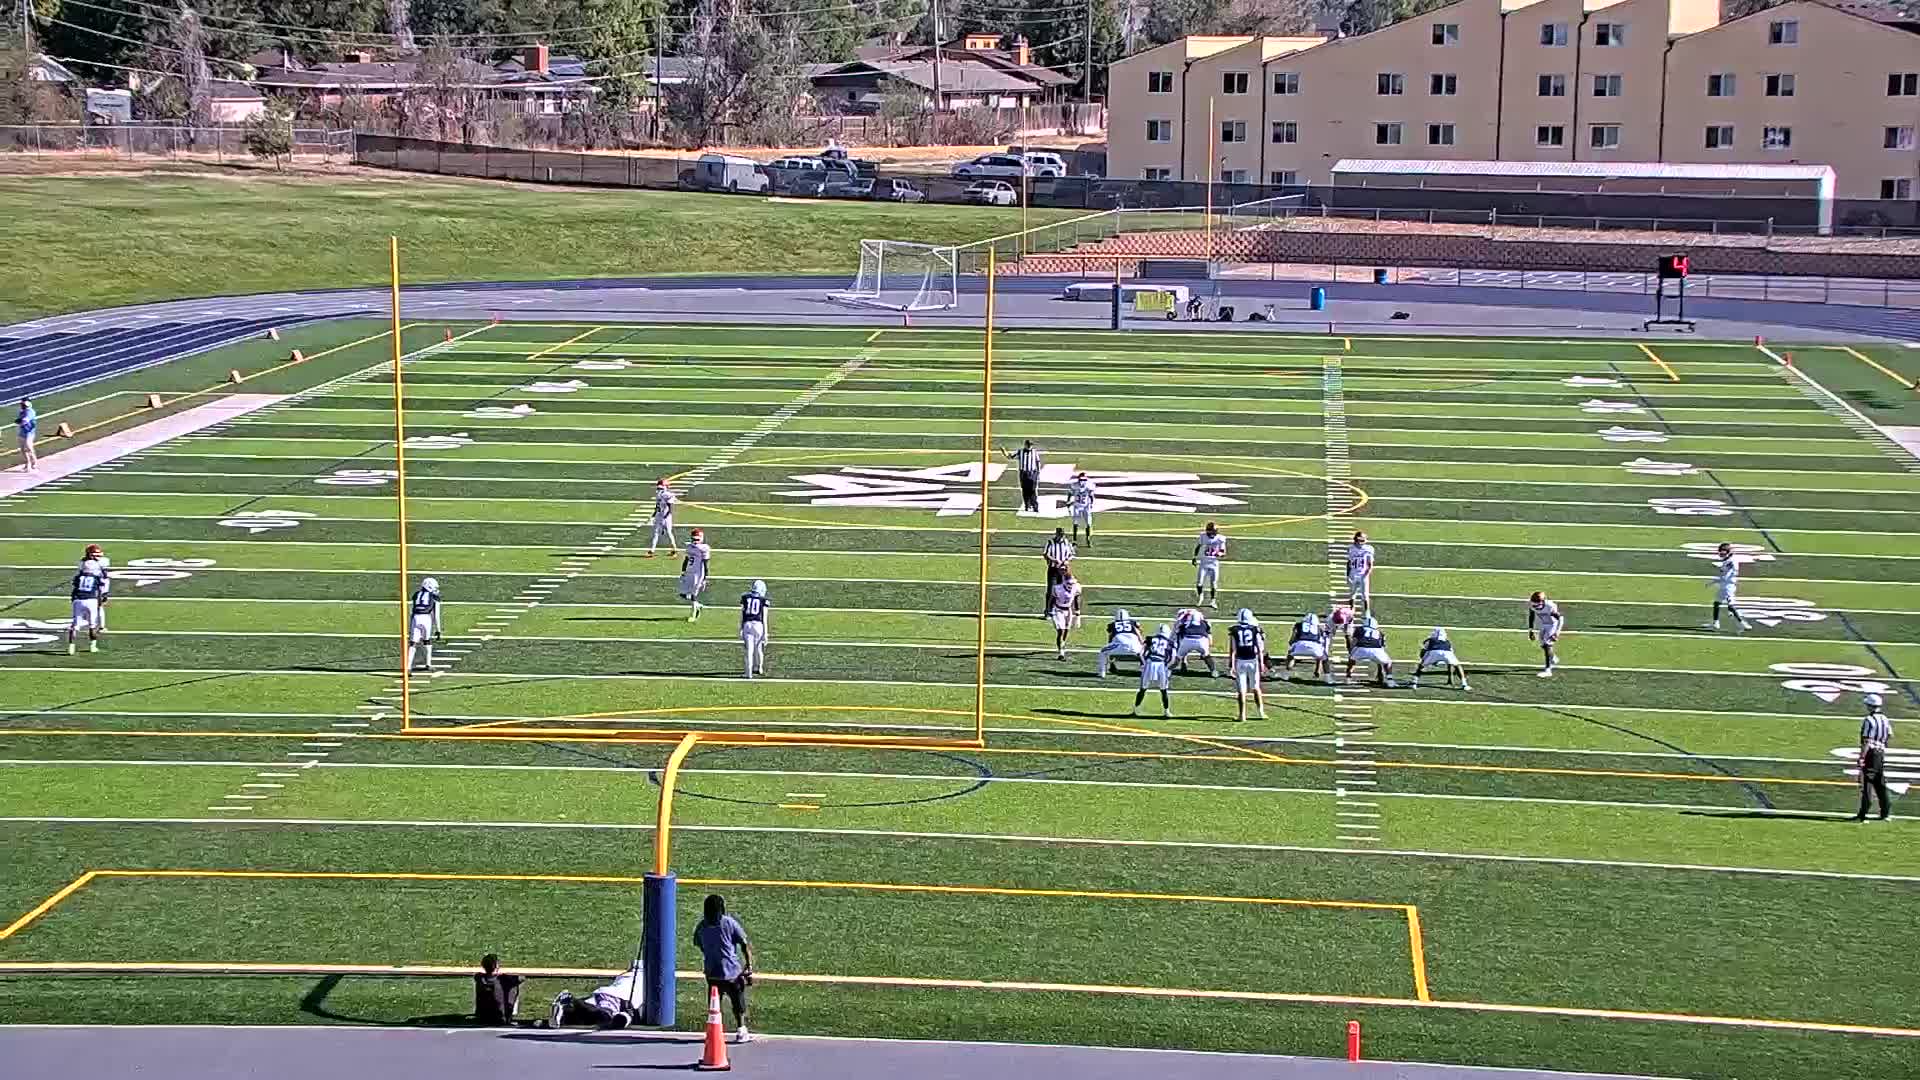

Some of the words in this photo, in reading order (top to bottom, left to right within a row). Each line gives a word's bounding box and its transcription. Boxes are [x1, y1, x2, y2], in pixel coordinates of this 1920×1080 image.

[1673, 256, 1688, 277] 4
[746, 597, 761, 615] 10
[1114, 621, 1133, 633] 55
[1237, 629, 1254, 647] 12
